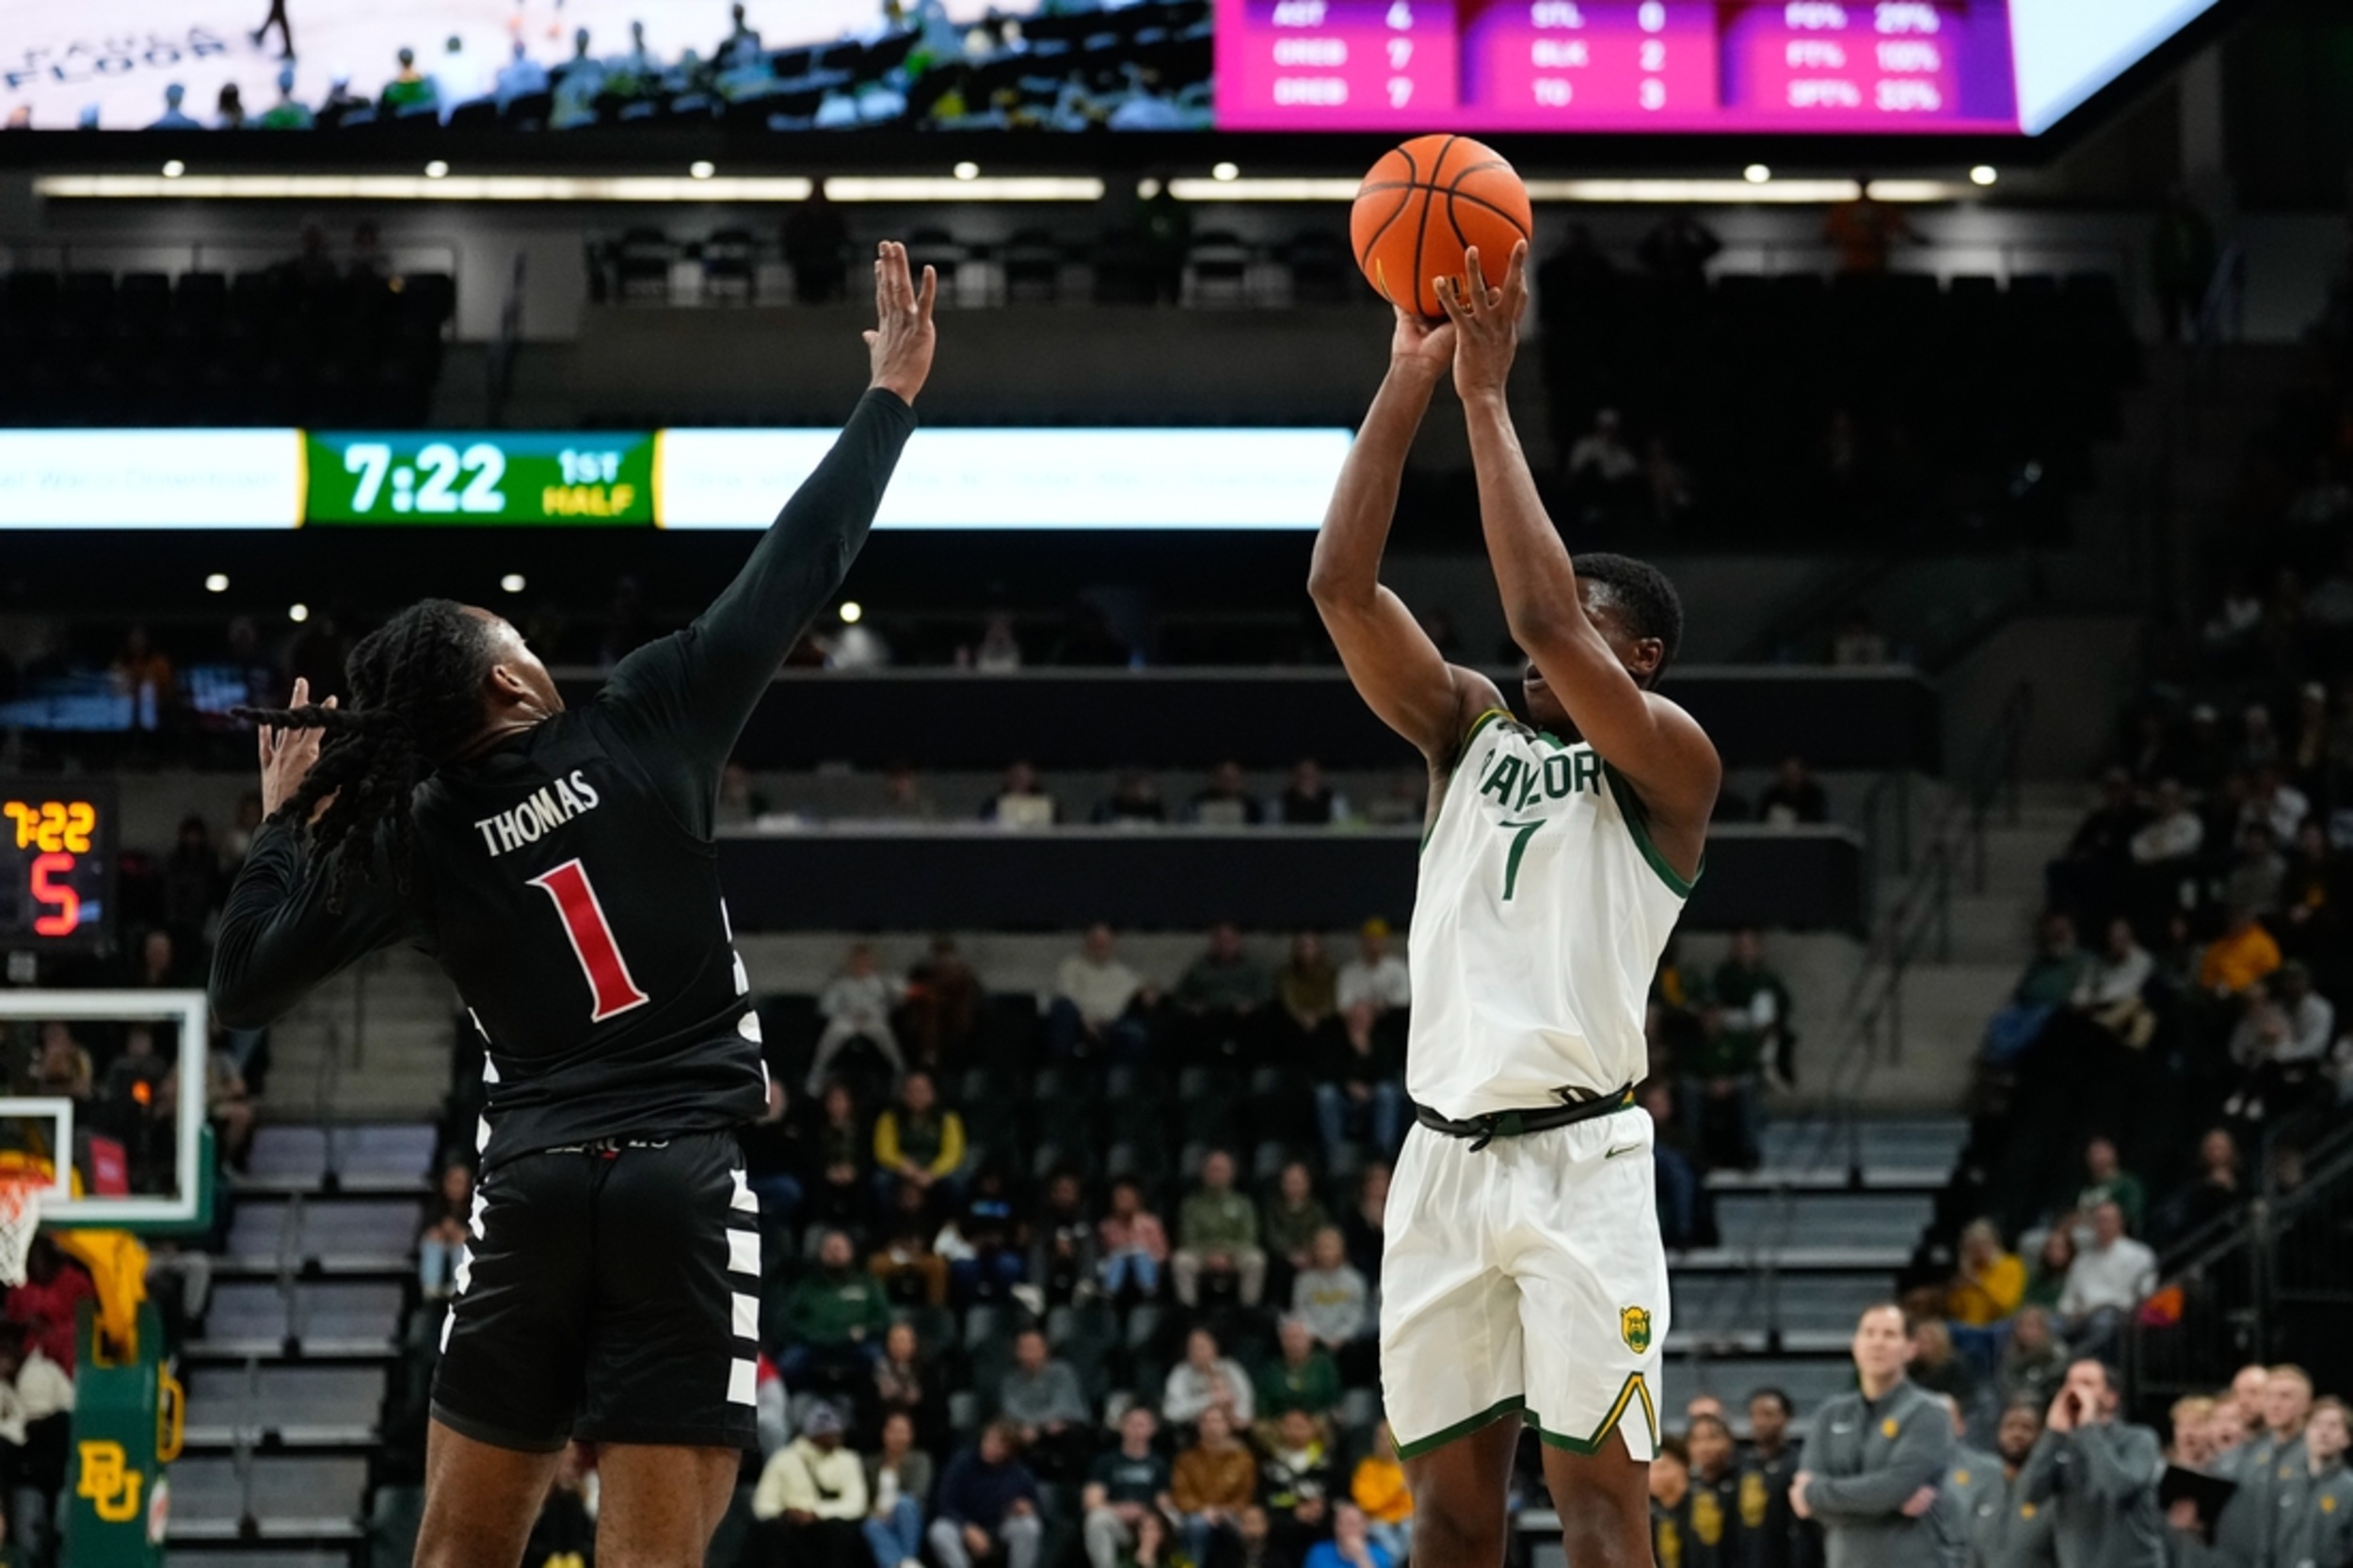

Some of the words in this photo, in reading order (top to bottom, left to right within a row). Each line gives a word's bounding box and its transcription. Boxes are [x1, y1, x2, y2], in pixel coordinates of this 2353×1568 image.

[1385, 37, 1415, 71] 7
[1639, 38, 1666, 72] 2
[1385, 75, 1415, 109] 7
[344, 443, 506, 513] 7:22
[558, 450, 624, 484] 1ST
[542, 485, 635, 516] HALF
[1474, 747, 1601, 812] AYLOR
[4, 802, 95, 854] 7:22
[474, 769, 600, 856] THOMAS
[1497, 818, 1547, 901] 7
[31, 852, 80, 936] 5
[525, 857, 649, 1023] 1
